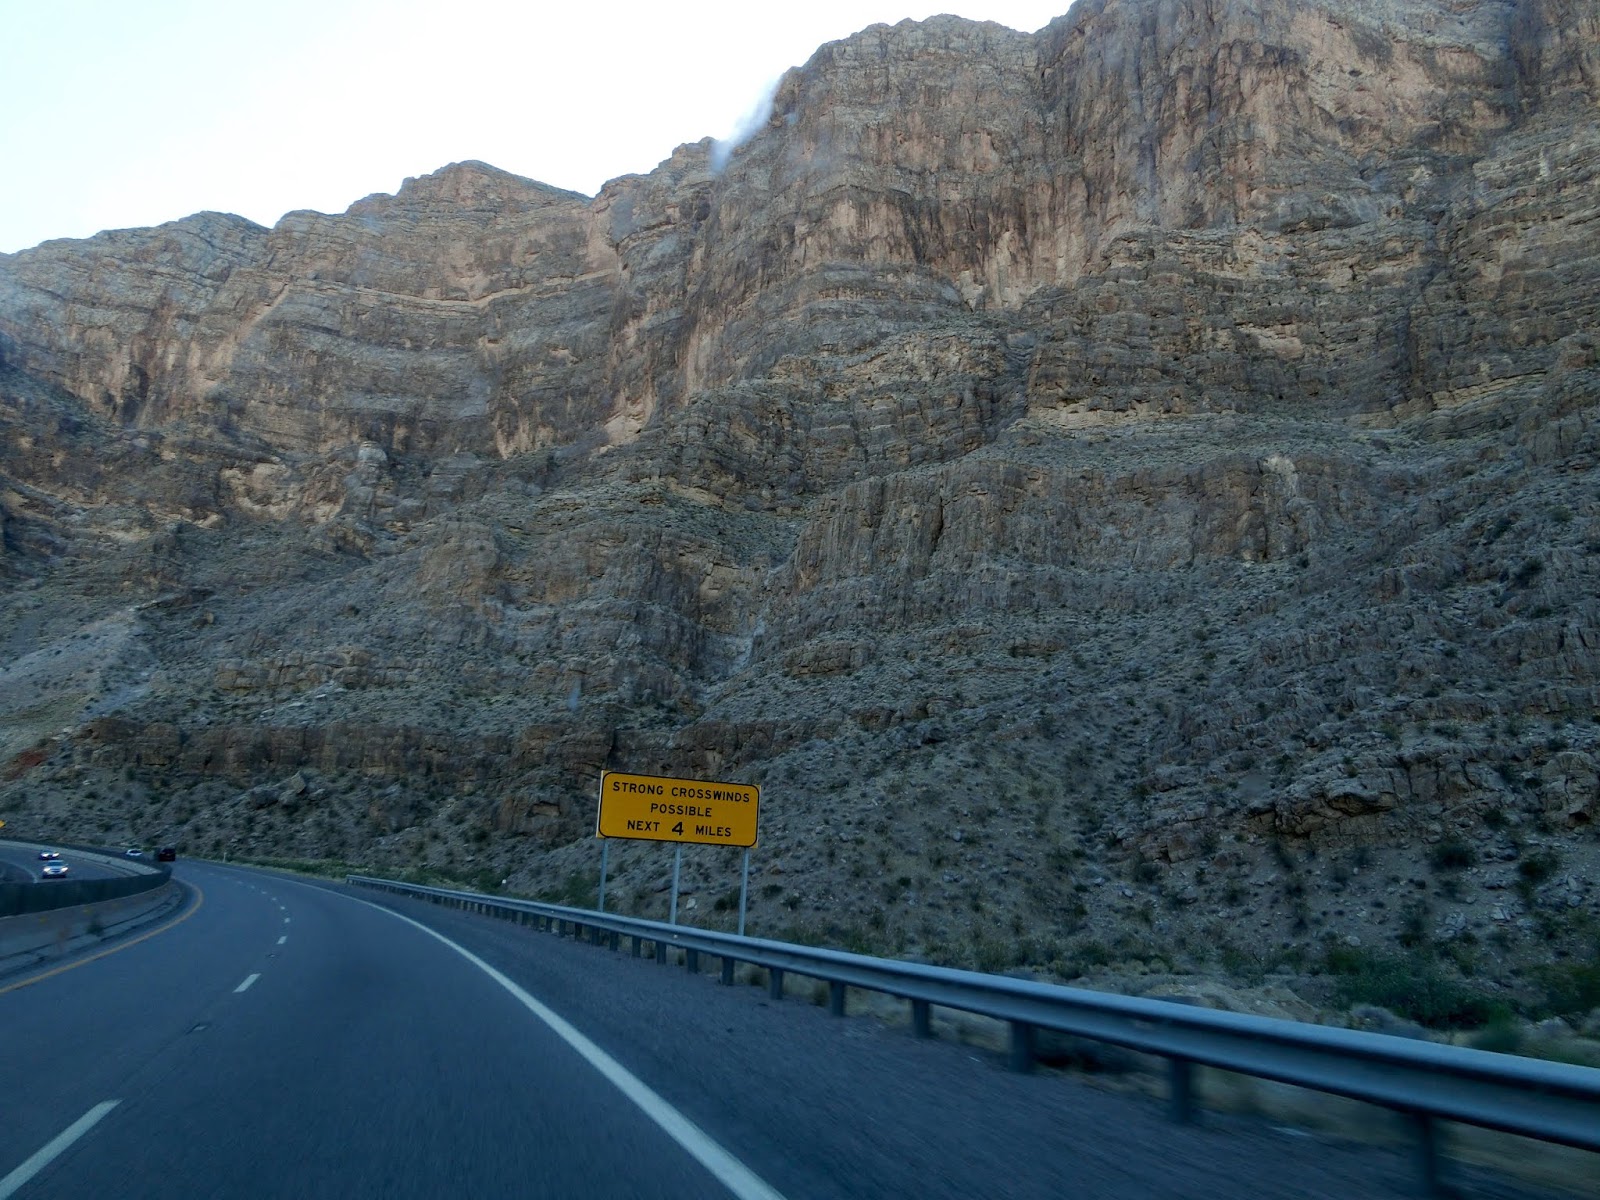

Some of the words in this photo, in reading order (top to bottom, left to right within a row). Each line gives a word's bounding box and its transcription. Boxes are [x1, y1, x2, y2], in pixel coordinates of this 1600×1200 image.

[612, 781, 664, 795] STRONG
[671, 787, 750, 802] CROSSWINDS
[650, 803, 712, 817] POSSIBLE
[627, 820, 660, 832] NEXT
[671, 821, 684, 836] 4
[695, 825, 731, 837] MILES
